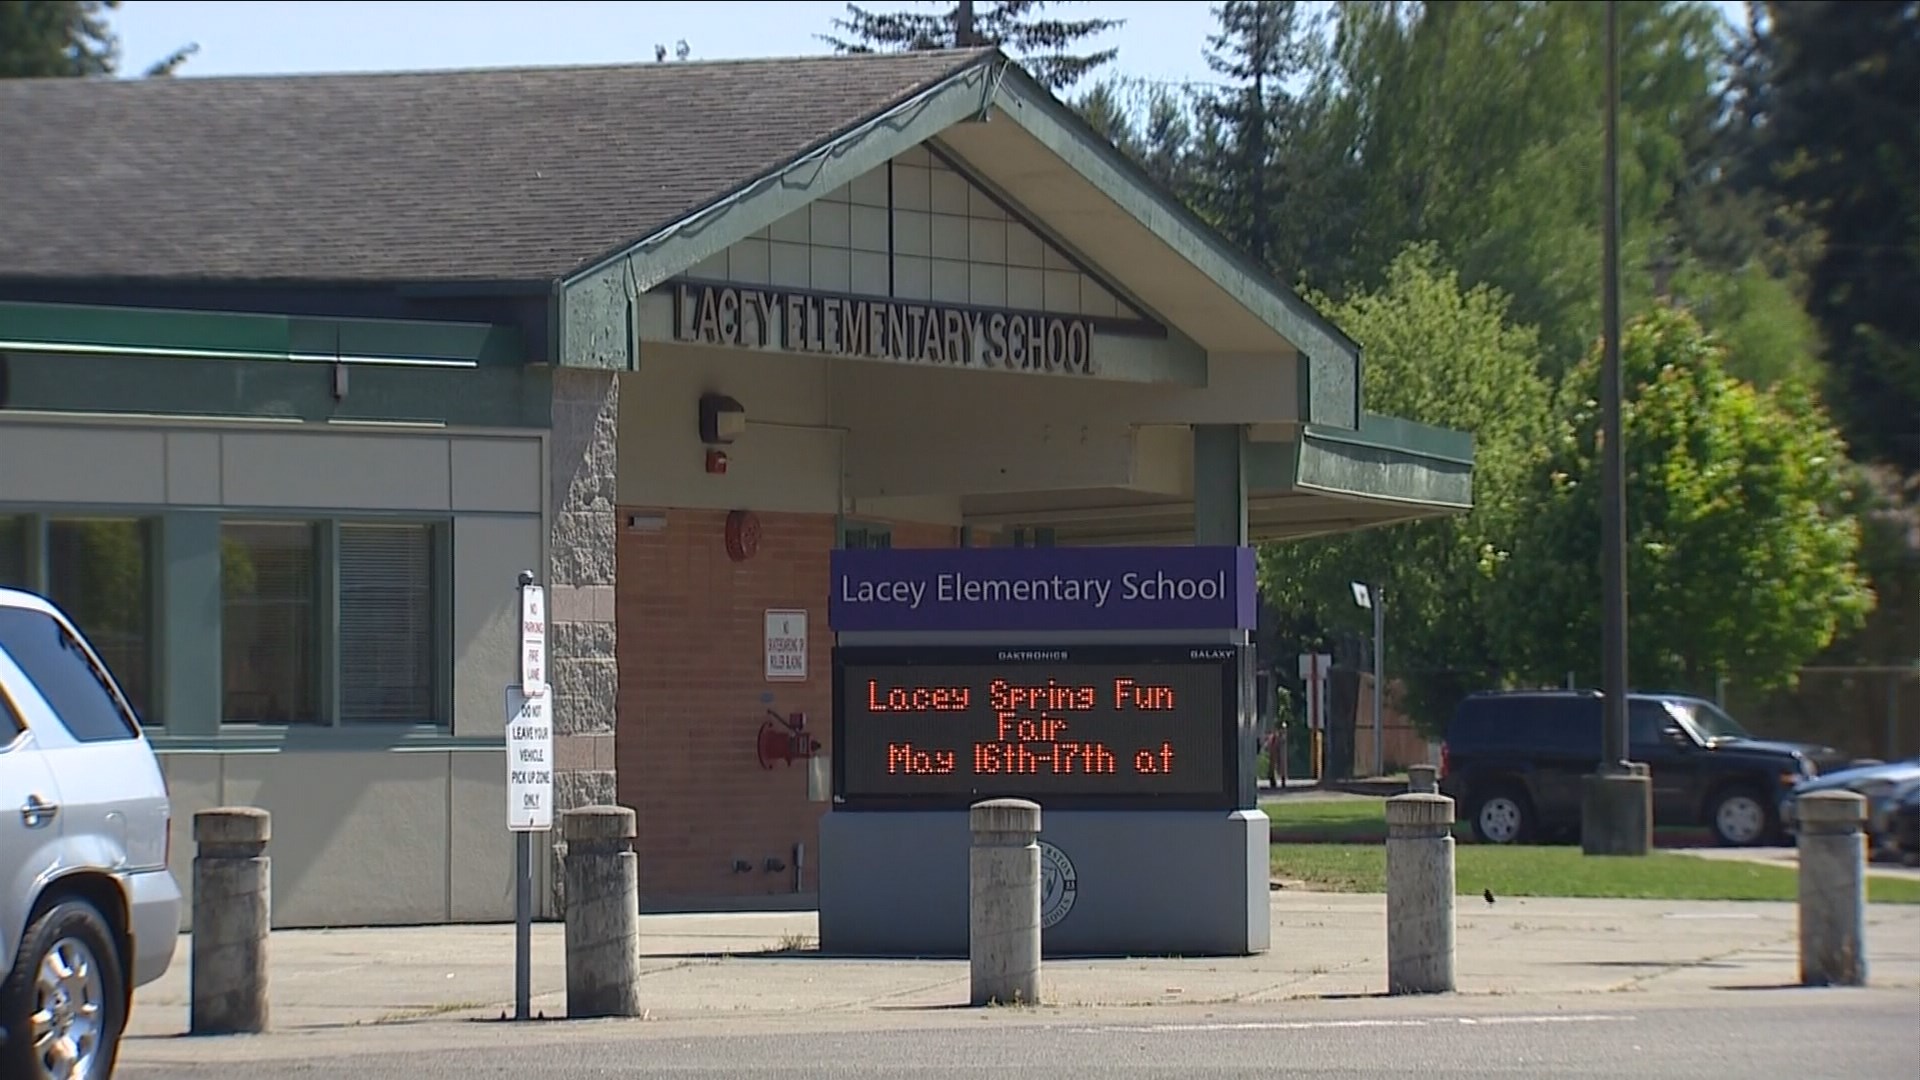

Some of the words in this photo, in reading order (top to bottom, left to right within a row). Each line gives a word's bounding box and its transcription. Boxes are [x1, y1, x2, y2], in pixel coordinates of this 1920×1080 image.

[680, 284, 779, 347] LACEY
[786, 294, 982, 367] ELEMENTARY
[988, 313, 1096, 374] SCHOOL
[842, 574, 926, 608] Lacey
[938, 572, 1111, 607] Elementary
[1123, 571, 1226, 600] School
[524, 621, 544, 634] PARKING
[528, 649, 539, 662] FIRE
[998, 651, 1068, 660] DAKTRONICS
[527, 668, 540, 680] LANE
[867, 679, 970, 711] Lacey
[990, 679, 1096, 711] Spring
[1114, 679, 1174, 711] Fun
[520, 704, 531, 718] DO
[532, 704, 542, 718] NOT
[512, 726, 533, 740] LEAVE
[534, 726, 549, 740] YOUR
[998, 711, 1069, 741] Fair
[519, 749, 544, 762] VEHICLE
[887, 742, 956, 774] May
[973, 742, 1115, 774] 16th-17th
[1134, 742, 1174, 774] at
[512, 771, 527, 784] PICK
[527, 771, 535, 784] UP
[536, 771, 550, 784] ZONE
[523, 793, 540, 807] ONLY
